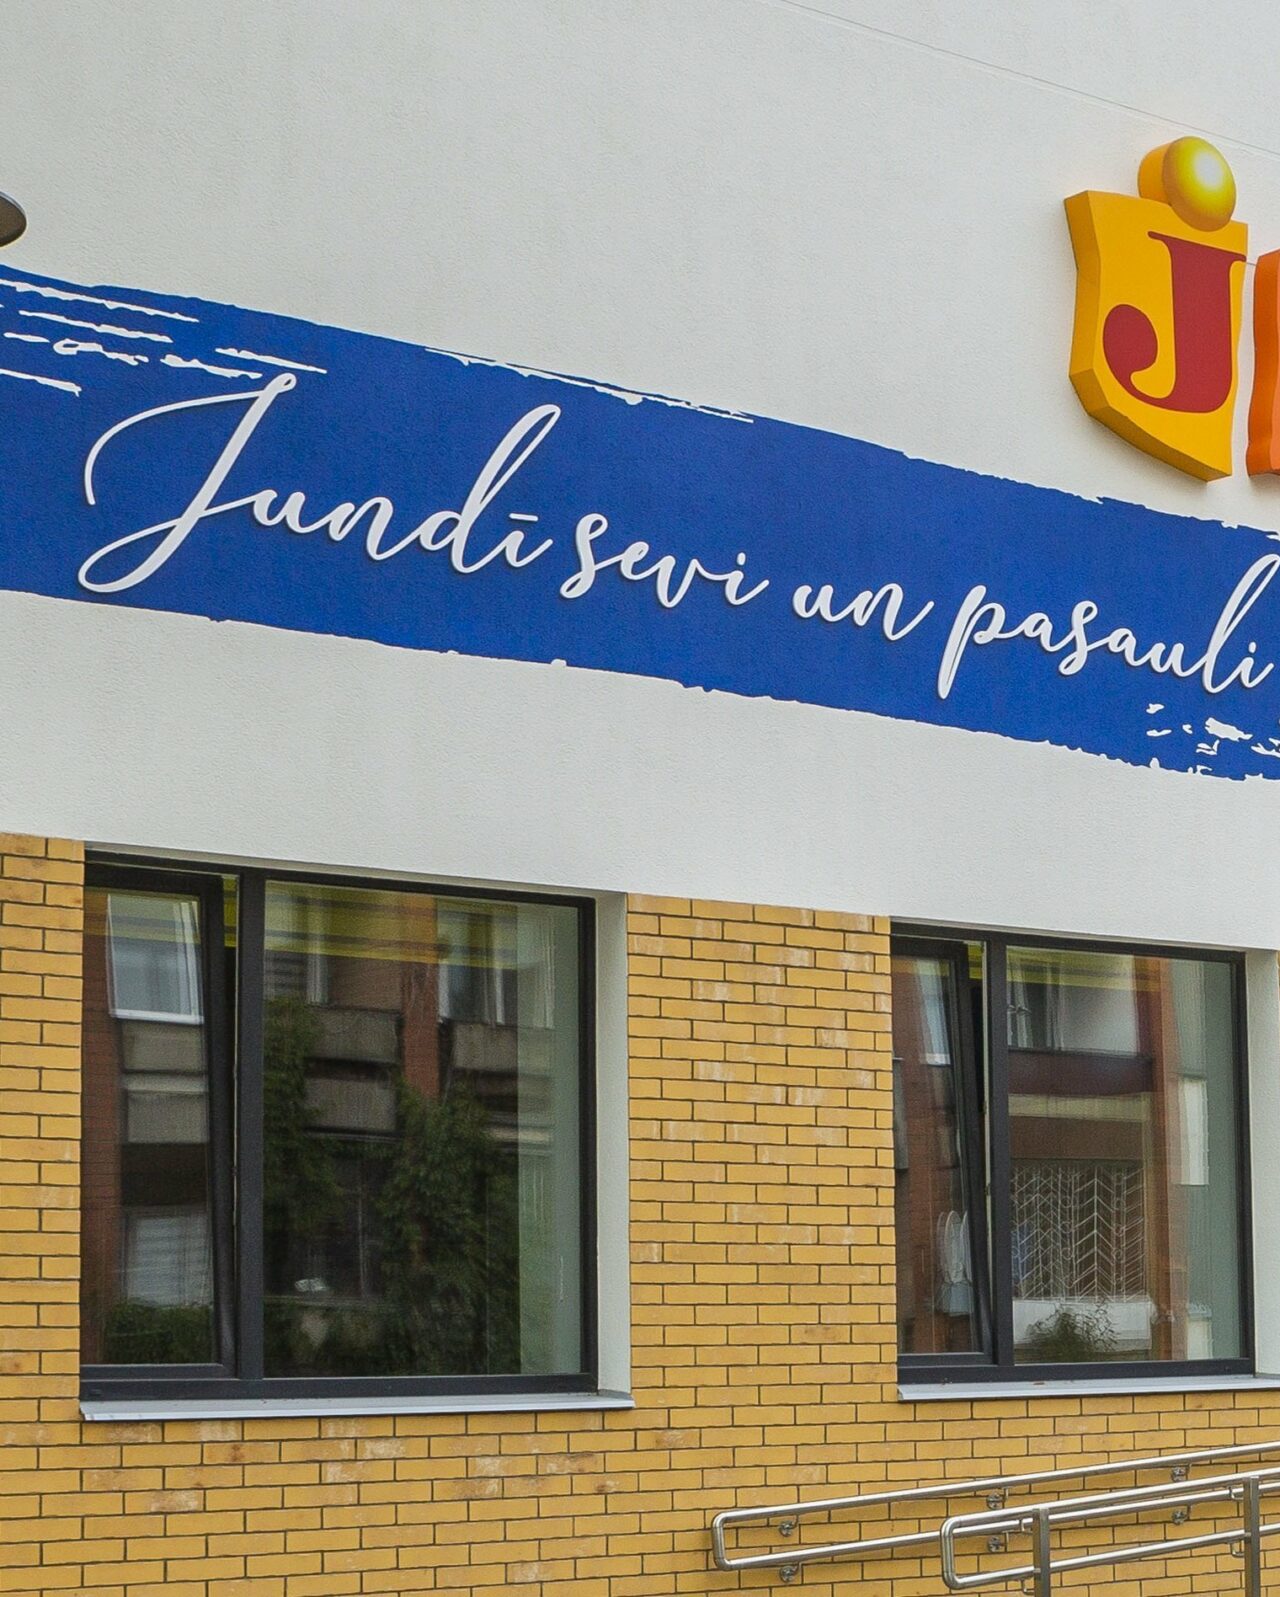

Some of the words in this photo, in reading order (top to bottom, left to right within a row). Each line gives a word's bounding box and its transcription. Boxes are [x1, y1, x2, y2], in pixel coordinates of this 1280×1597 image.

[78, 373, 561, 592] Jundī
[560, 514, 769, 606] sevi
[793, 582, 934, 640] un
